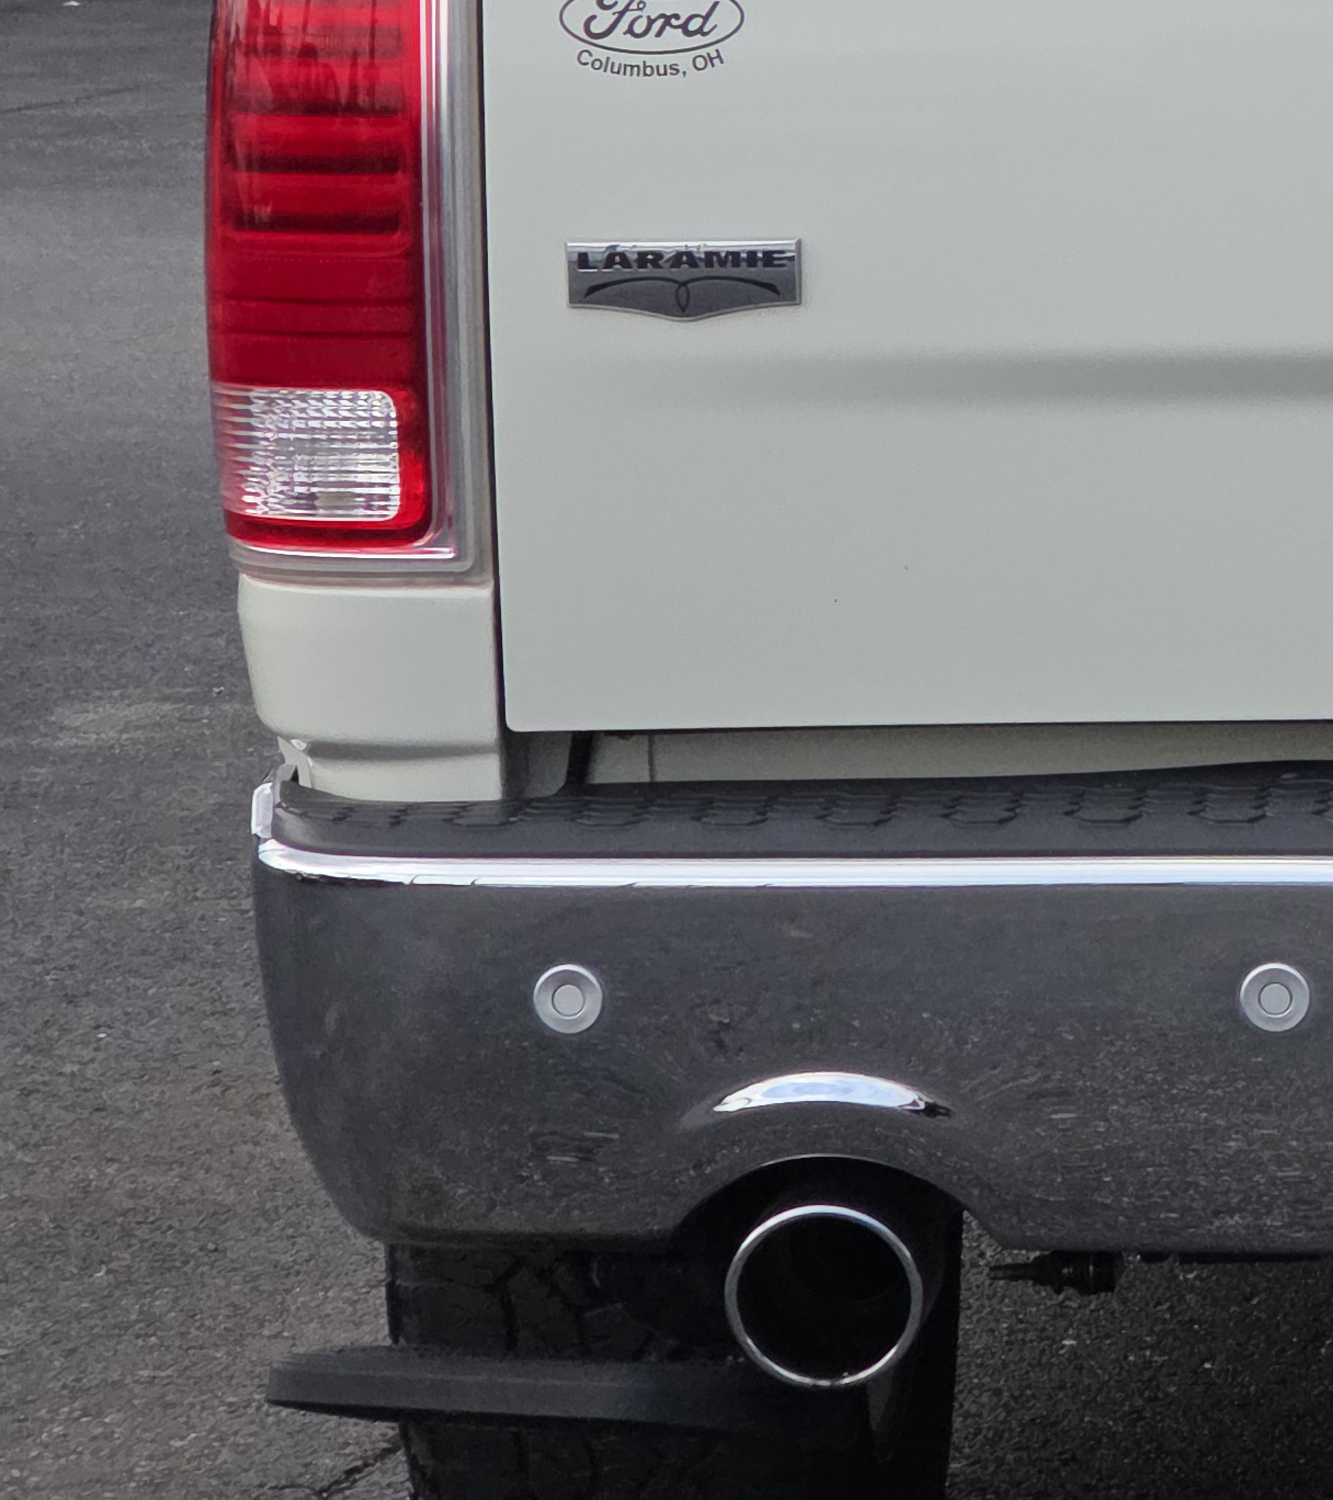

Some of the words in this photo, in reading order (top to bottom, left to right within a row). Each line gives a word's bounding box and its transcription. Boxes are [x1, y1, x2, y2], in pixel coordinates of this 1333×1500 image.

[576, 49, 687, 78] Columbus,
[691, 48, 725, 71] OH
[577, 249, 795, 270] LARAMIE
